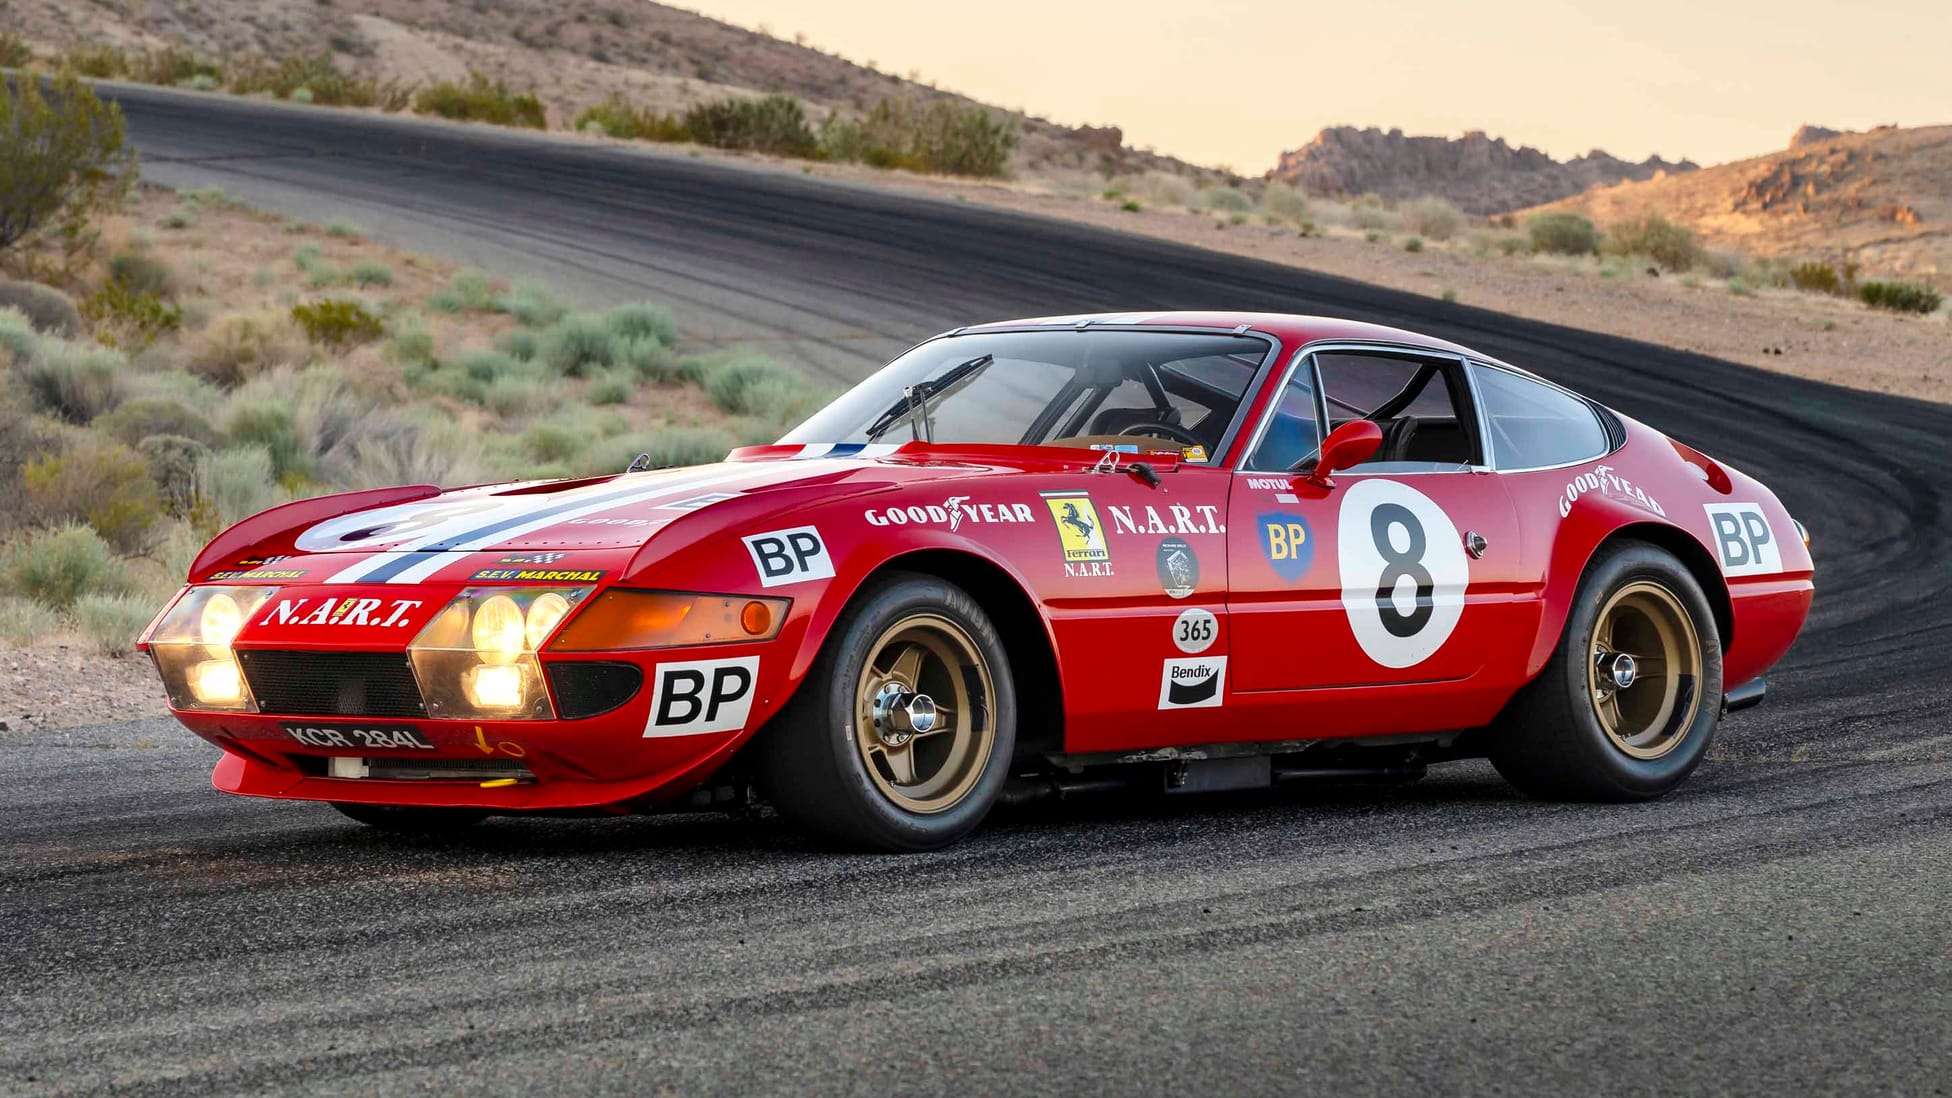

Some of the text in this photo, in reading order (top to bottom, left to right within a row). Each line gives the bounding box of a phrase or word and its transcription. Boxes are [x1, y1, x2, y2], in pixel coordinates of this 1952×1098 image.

[1247, 479, 1293, 490] MOTUL
[1108, 504, 1226, 534] N.A.R.T.
[1267, 523, 1305, 560] BP
[1711, 511, 1771, 567] BP
[751, 532, 821, 578] BP
[1067, 549, 1106, 558] Ferrari
[514, 571, 601, 581] MARCHAL
[1064, 562, 1115, 577] N.A.R.T.
[1370, 503, 1434, 638] 8
[259, 598, 423, 628] N.A.R.T.
[1179, 619, 1211, 642] 365
[1171, 665, 1212, 679] Bendix
[655, 666, 752, 726] BP
[286, 728, 435, 749] KCR 284L
